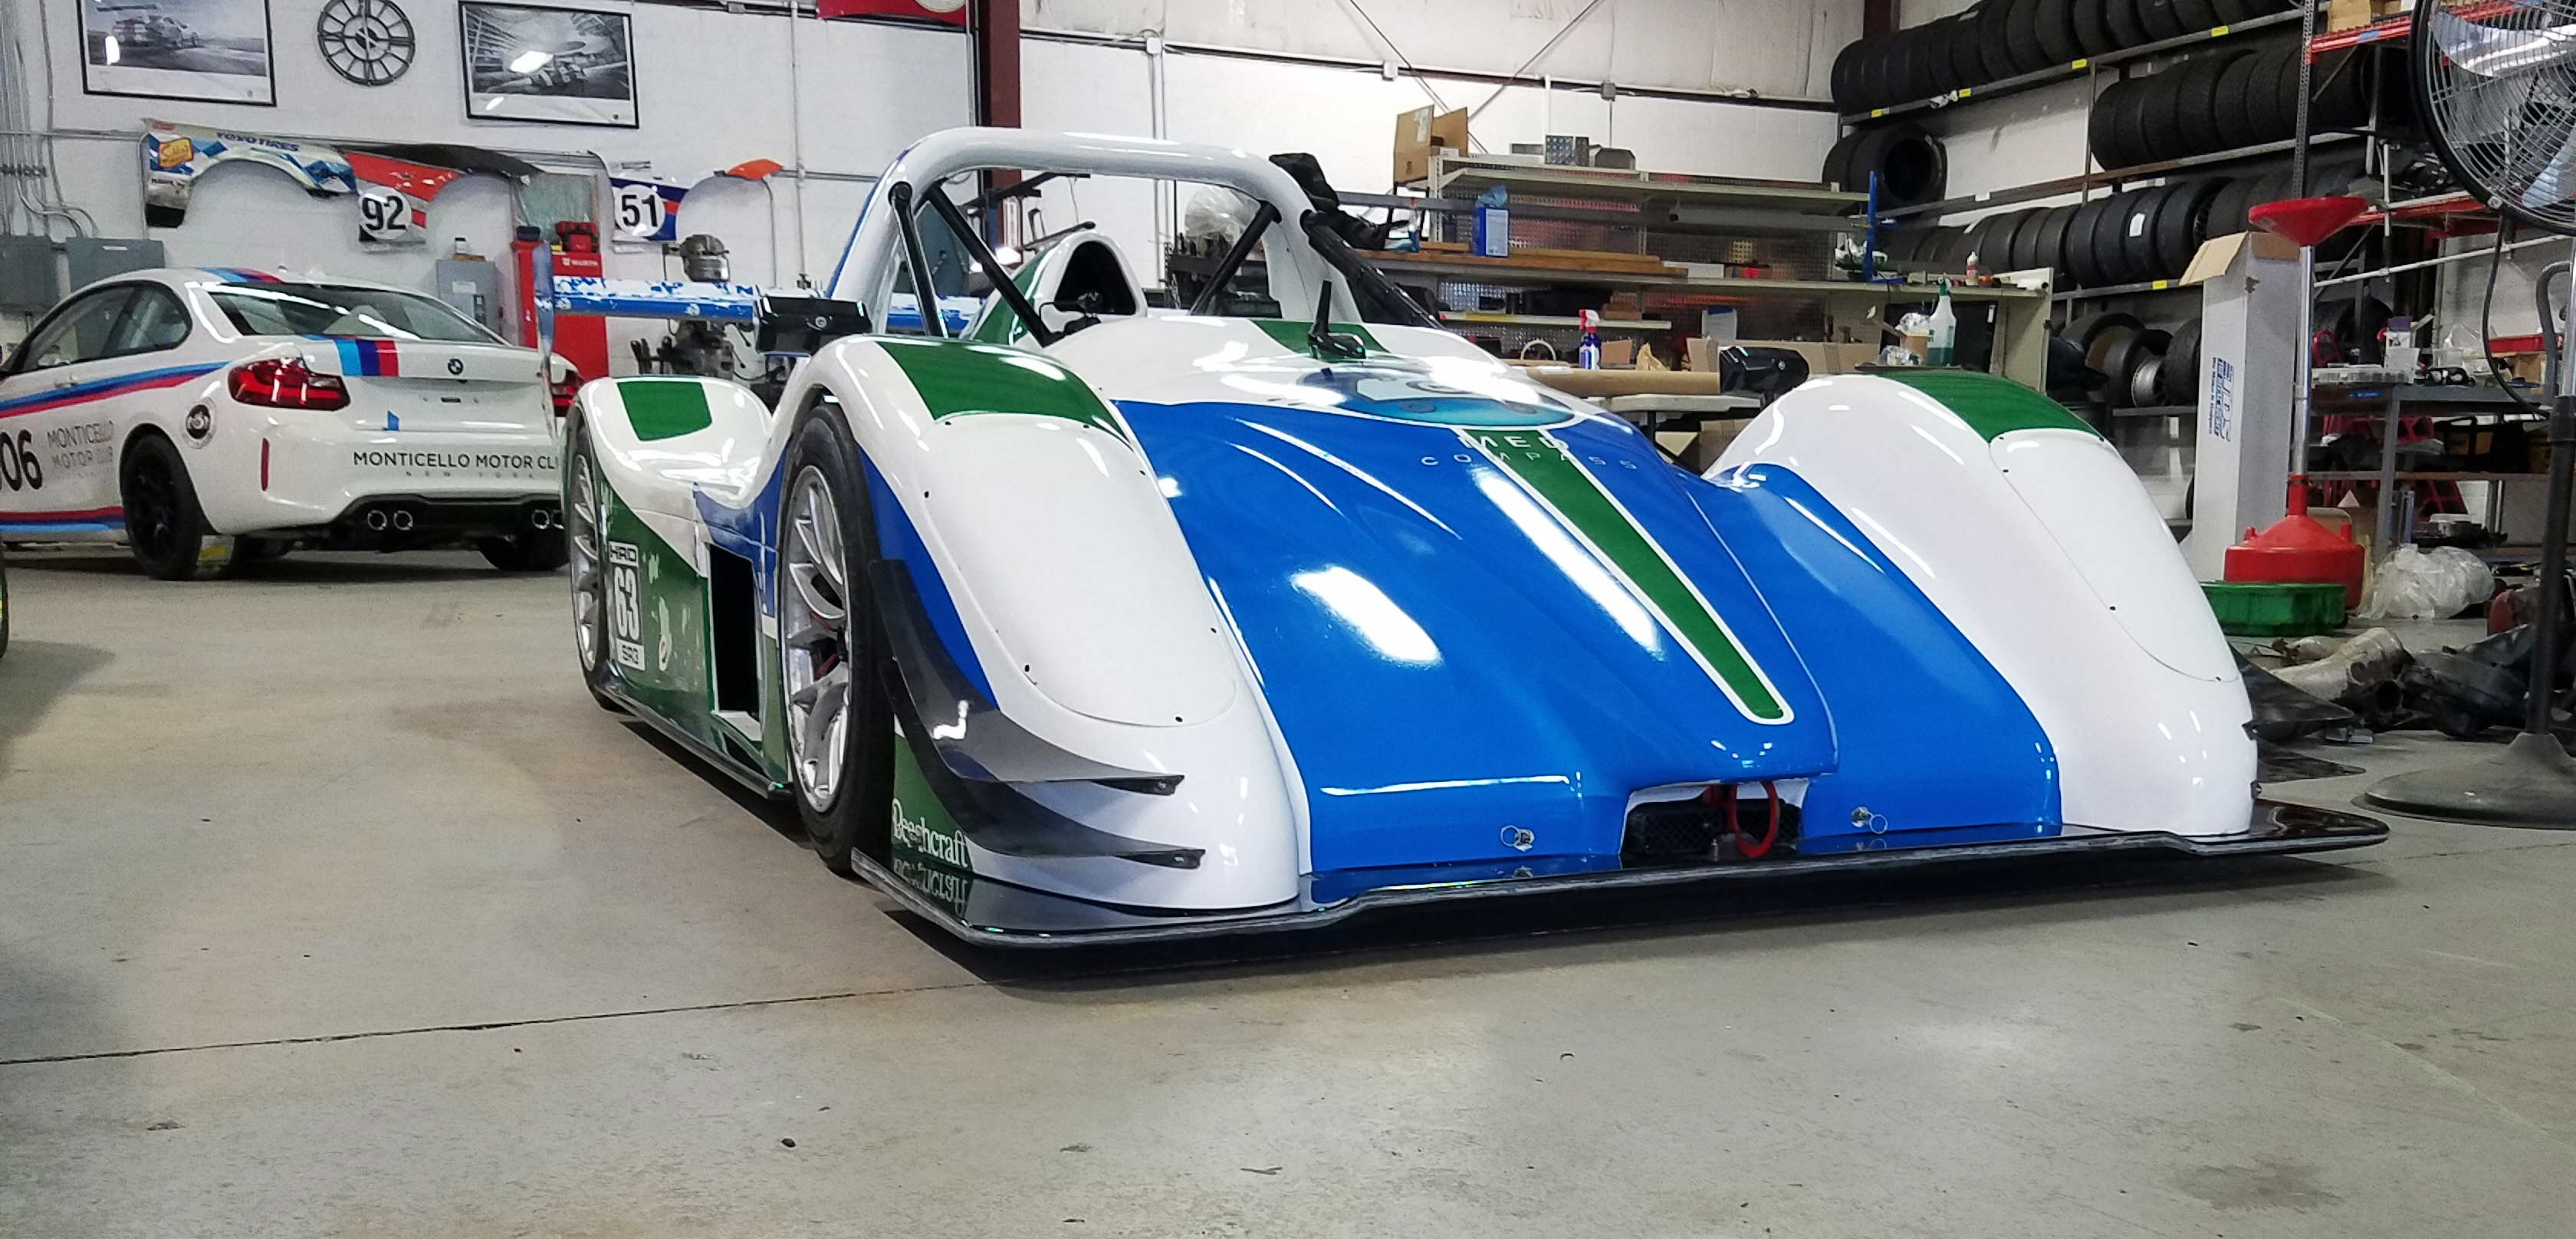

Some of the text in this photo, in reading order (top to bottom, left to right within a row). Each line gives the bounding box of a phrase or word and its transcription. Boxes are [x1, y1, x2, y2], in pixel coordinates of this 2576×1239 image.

[362, 196, 407, 230] 92
[621, 194, 658, 227] 51
[1457, 435, 1569, 449] MED
[0, 429, 42, 491] 06
[353, 451, 470, 468] MONTICELLO
[476, 455, 533, 468] MOTOR
[1421, 452, 1638, 470] COMPASS
[614, 567, 640, 641] 63
